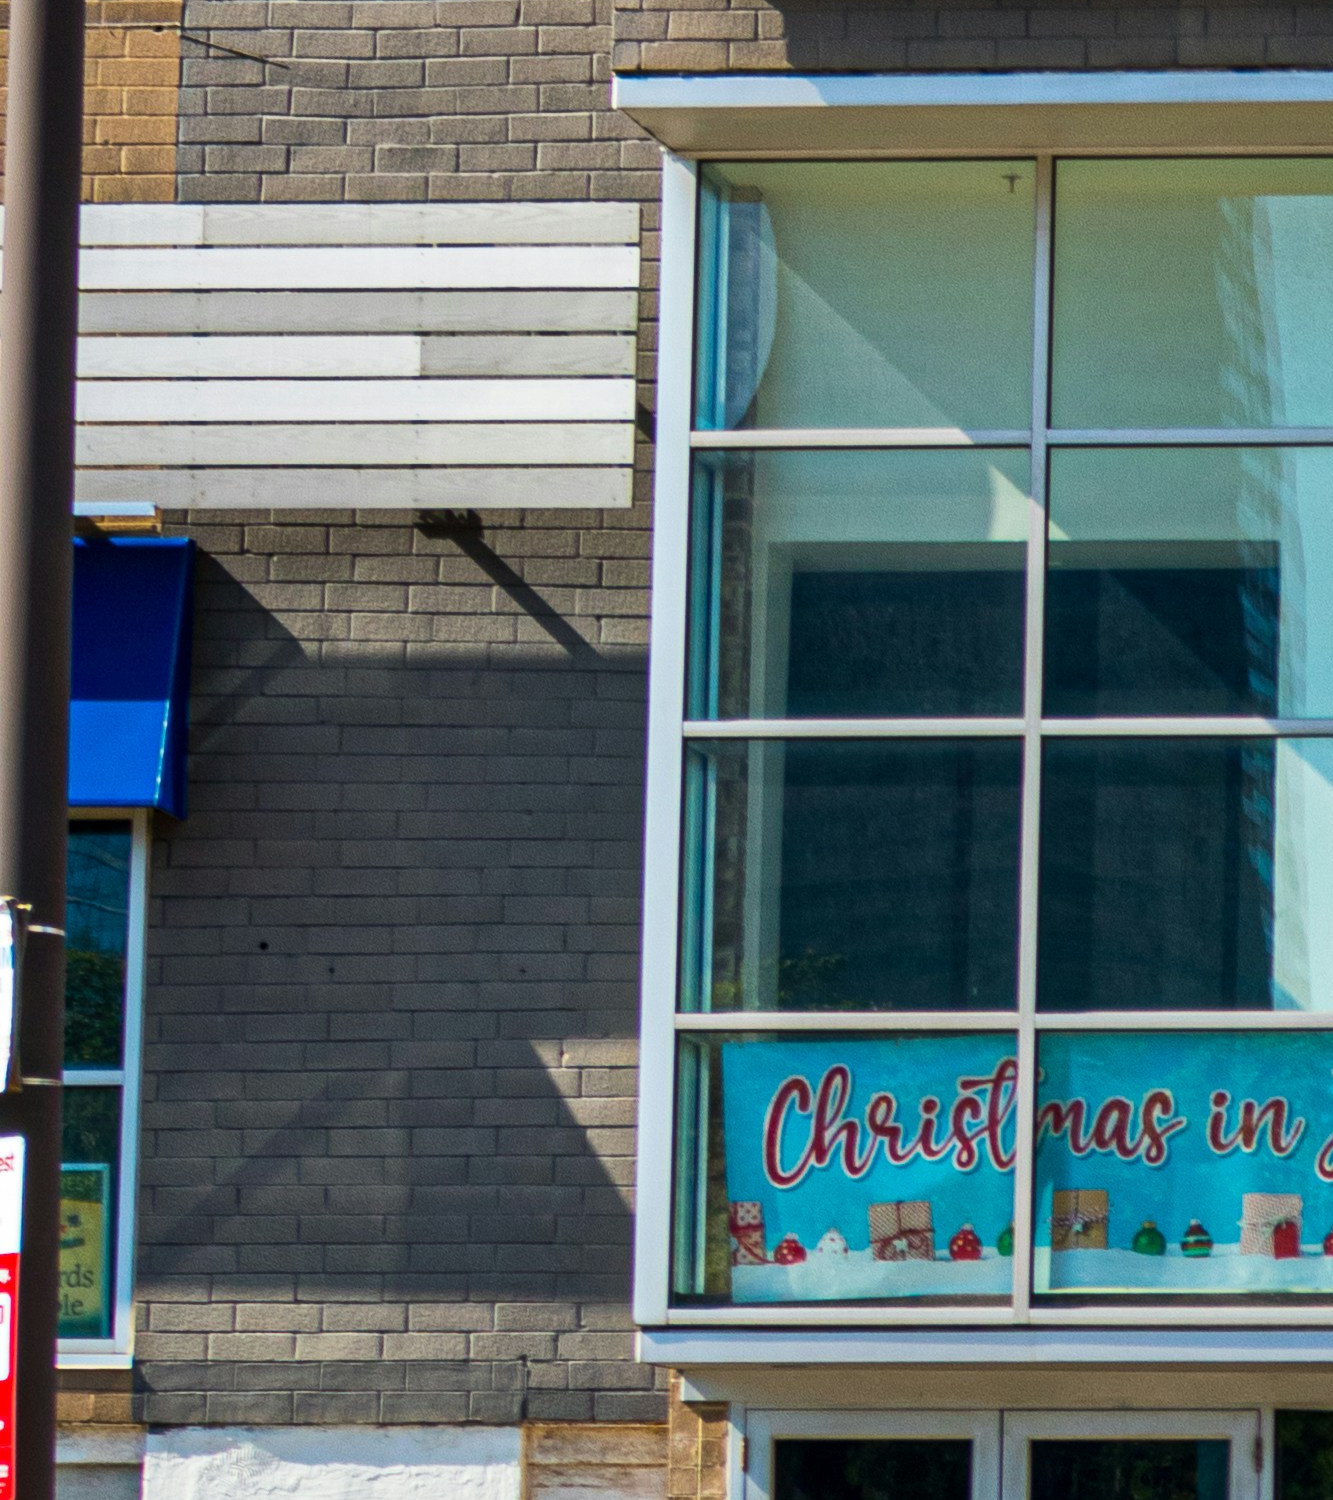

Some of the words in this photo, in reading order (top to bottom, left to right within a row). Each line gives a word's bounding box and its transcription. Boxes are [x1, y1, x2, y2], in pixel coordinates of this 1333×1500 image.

[763, 1057, 1186, 1190] Christmas
[1207, 1087, 1305, 1159] in
[58, 1263, 94, 1289] rds
